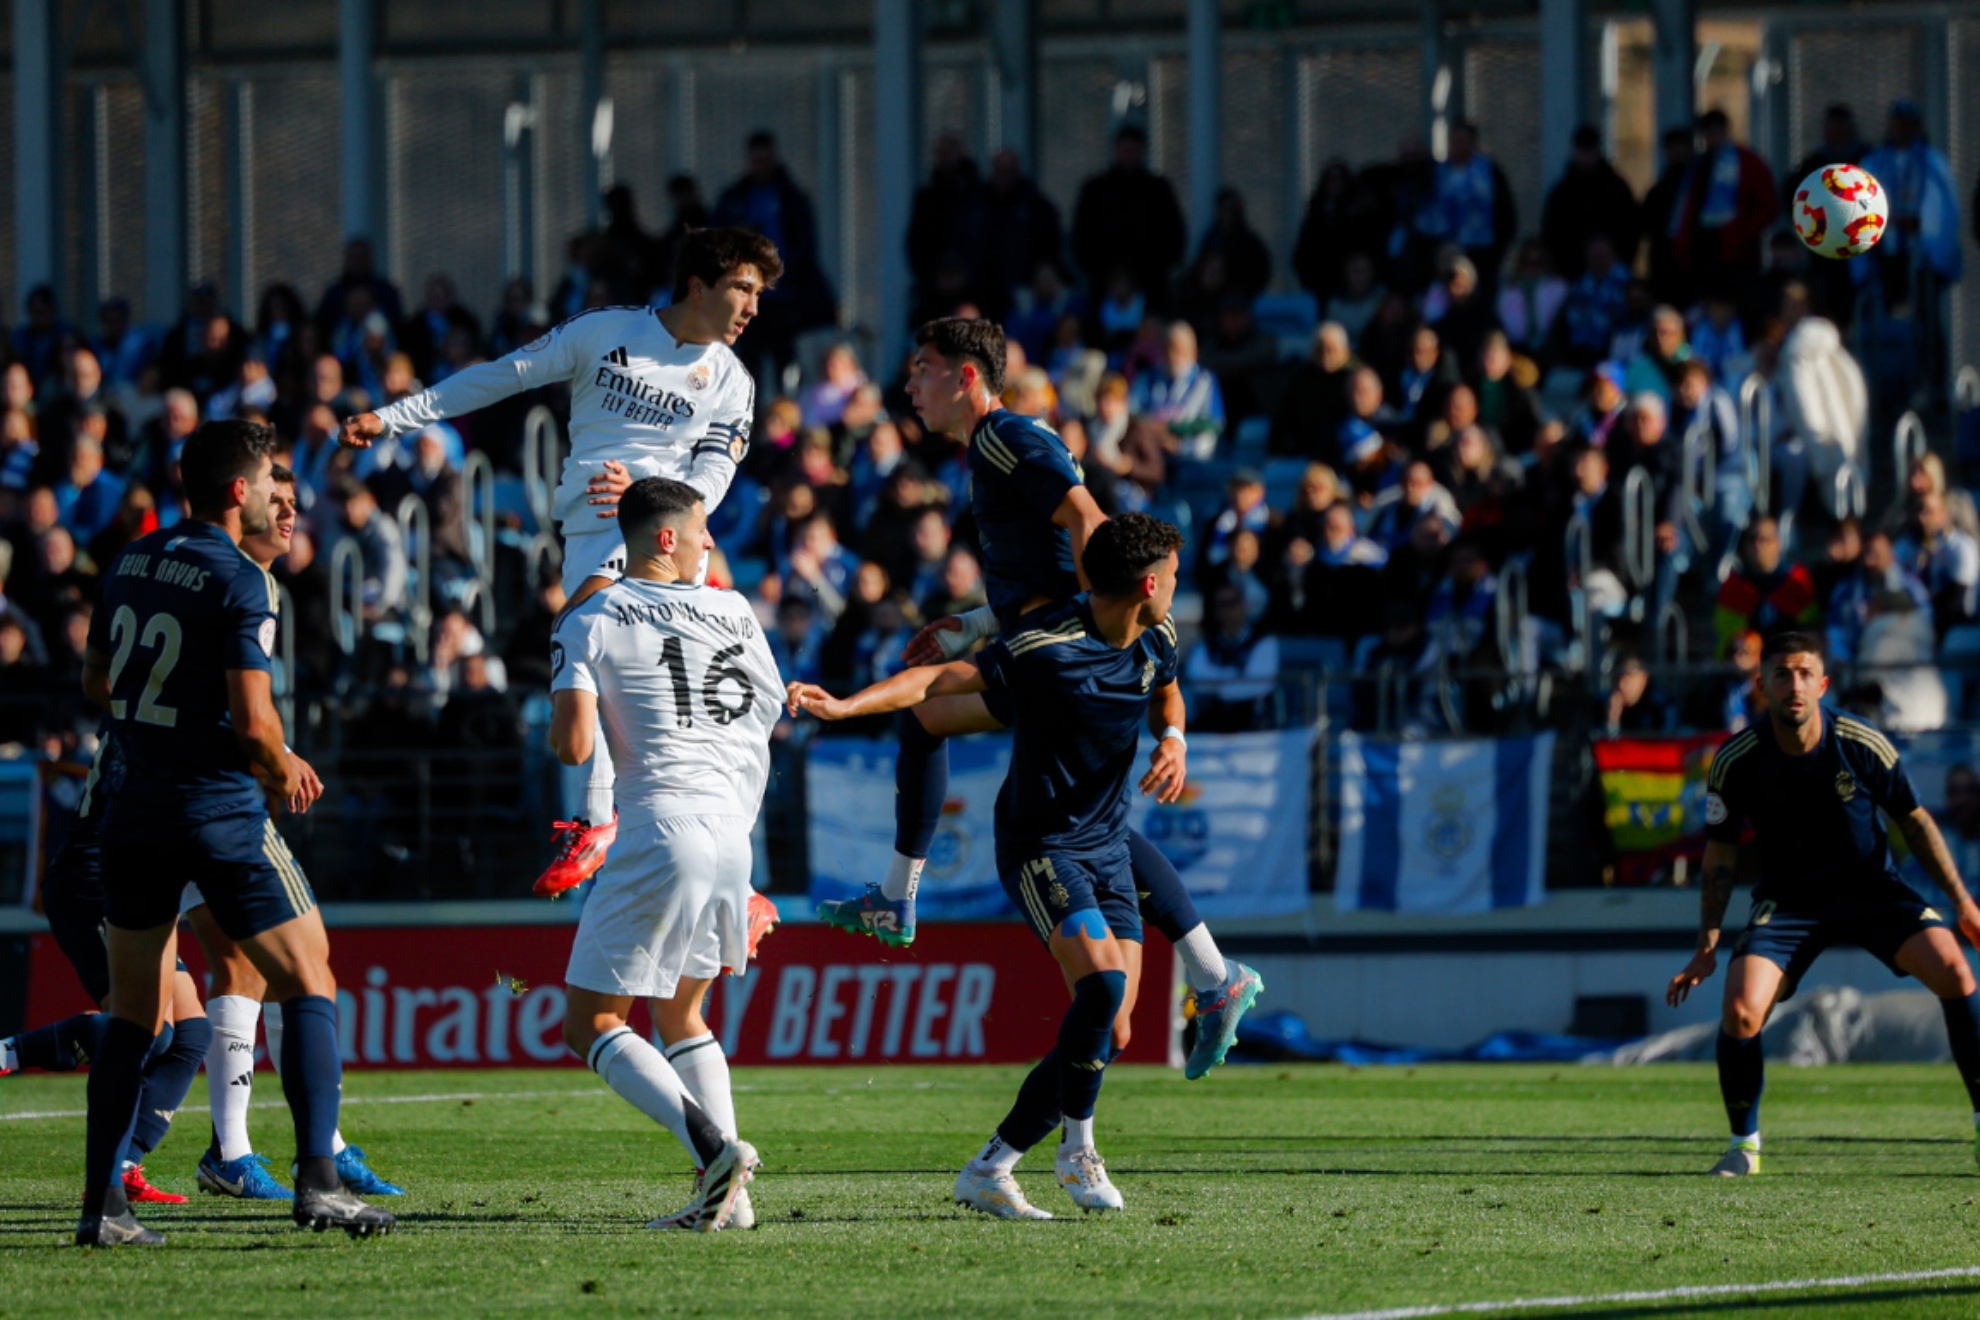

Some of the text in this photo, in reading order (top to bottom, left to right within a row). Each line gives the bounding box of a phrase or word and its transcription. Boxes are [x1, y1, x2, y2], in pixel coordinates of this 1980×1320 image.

[595, 366, 697, 418] Emirates
[601, 392, 675, 431] FLY BETTER
[154, 557, 212, 592] NAVAS
[109, 604, 183, 728] 22
[656, 636, 755, 729] 16
[1030, 856, 1057, 881] 4
[766, 962, 996, 1058] BETTER
